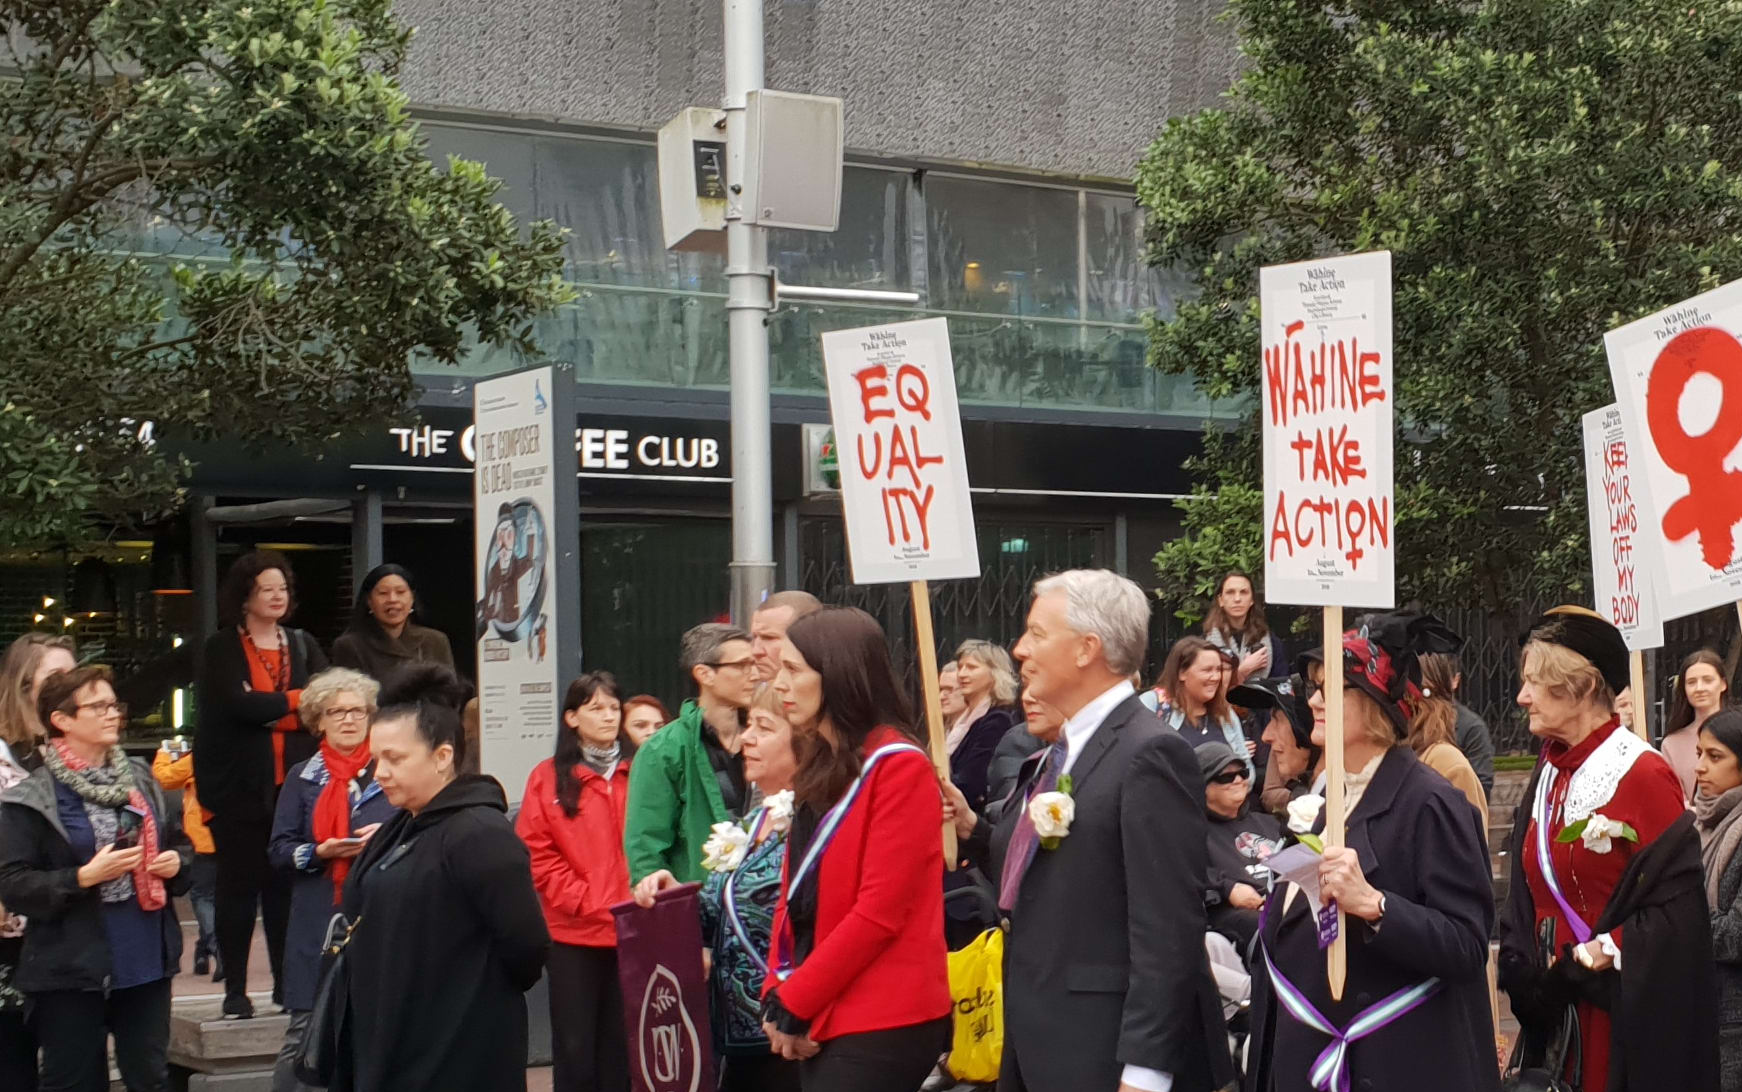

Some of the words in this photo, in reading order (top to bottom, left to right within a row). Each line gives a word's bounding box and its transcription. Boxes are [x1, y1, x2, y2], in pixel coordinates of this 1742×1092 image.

[853, 363, 932, 425] EQ
[388, 424, 454, 458] THE
[636, 436, 720, 469] CLUB
[857, 423, 944, 490] UAL
[1290, 423, 1368, 488] TAKE
[1602, 474, 1633, 512] YOUR
[881, 484, 935, 551] ITY
[1269, 489, 1389, 572] ACTION
[1609, 503, 1638, 536] LAWS
[1612, 535, 1633, 567] OFF
[1617, 563, 1635, 595] MY
[1611, 592, 1640, 627] BODY
